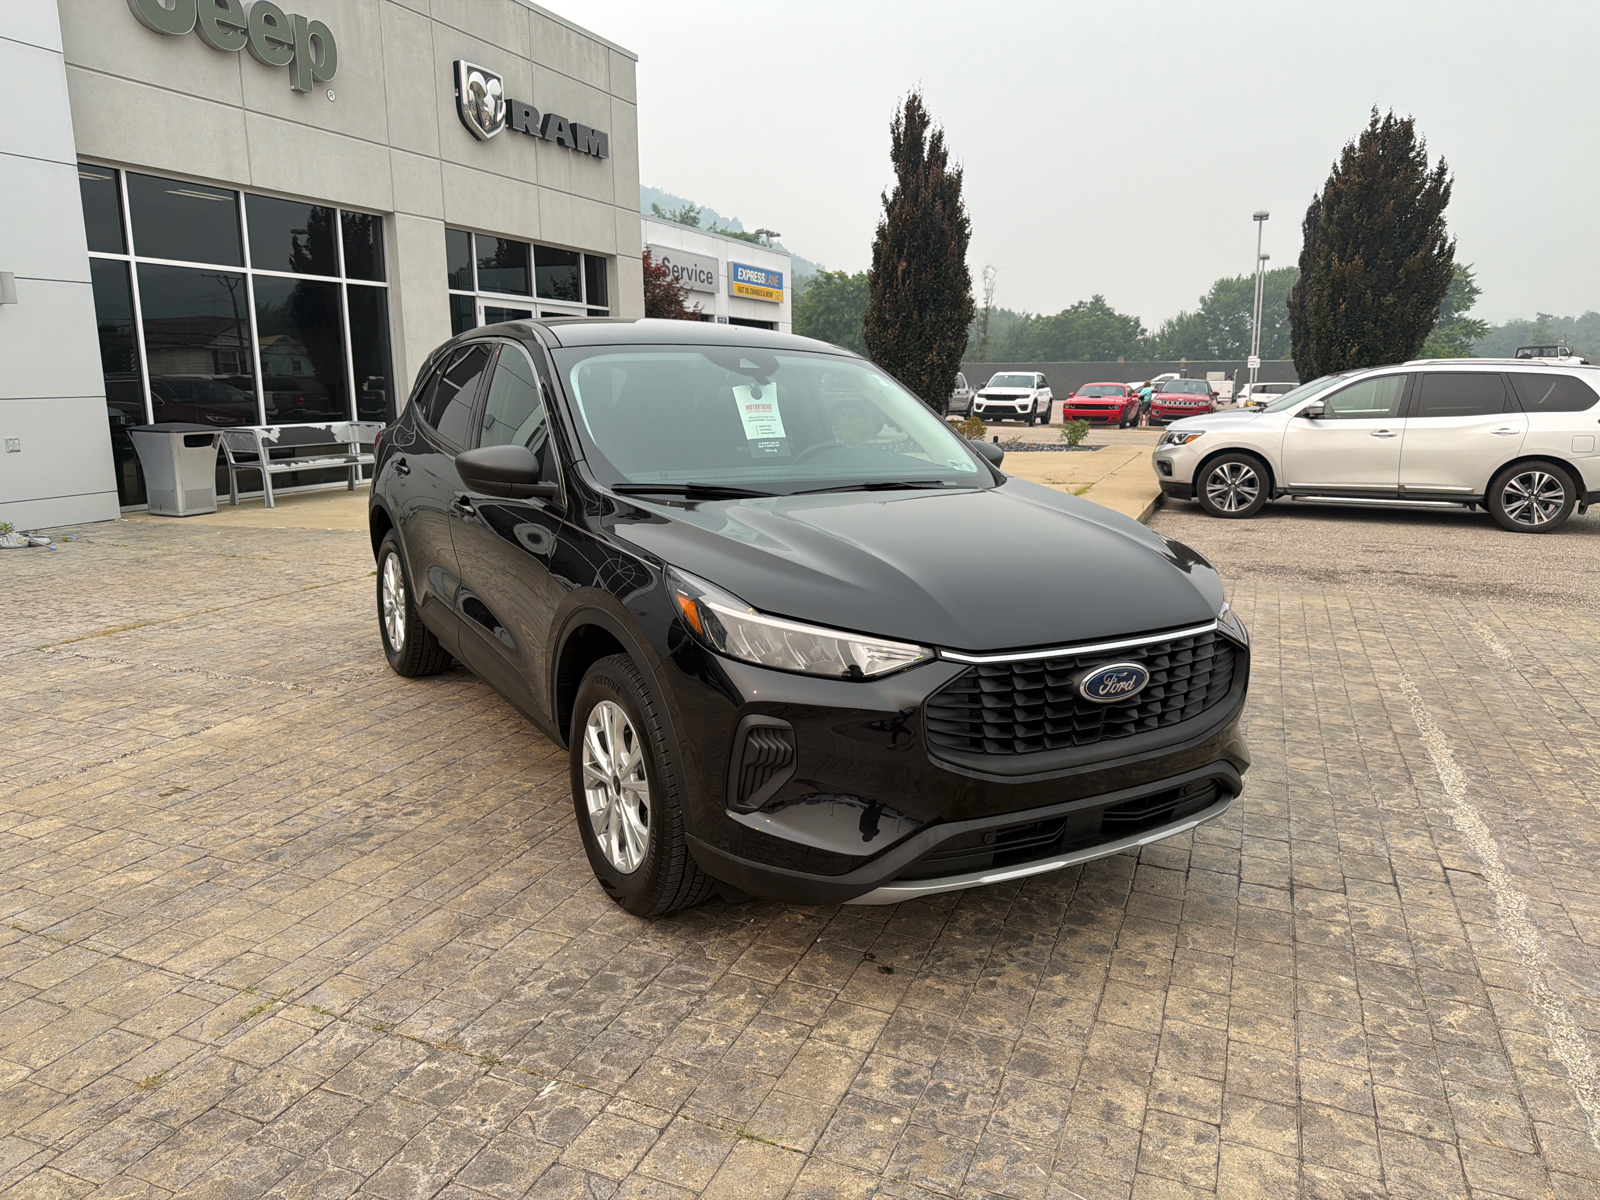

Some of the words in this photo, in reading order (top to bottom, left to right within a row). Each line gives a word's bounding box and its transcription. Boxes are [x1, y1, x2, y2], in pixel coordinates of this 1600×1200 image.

[506, 98, 609, 160] RAM
[661, 255, 714, 286] Service
[592, 674, 622, 697] FORTUNE
[1098, 671, 1137, 695] Ford
